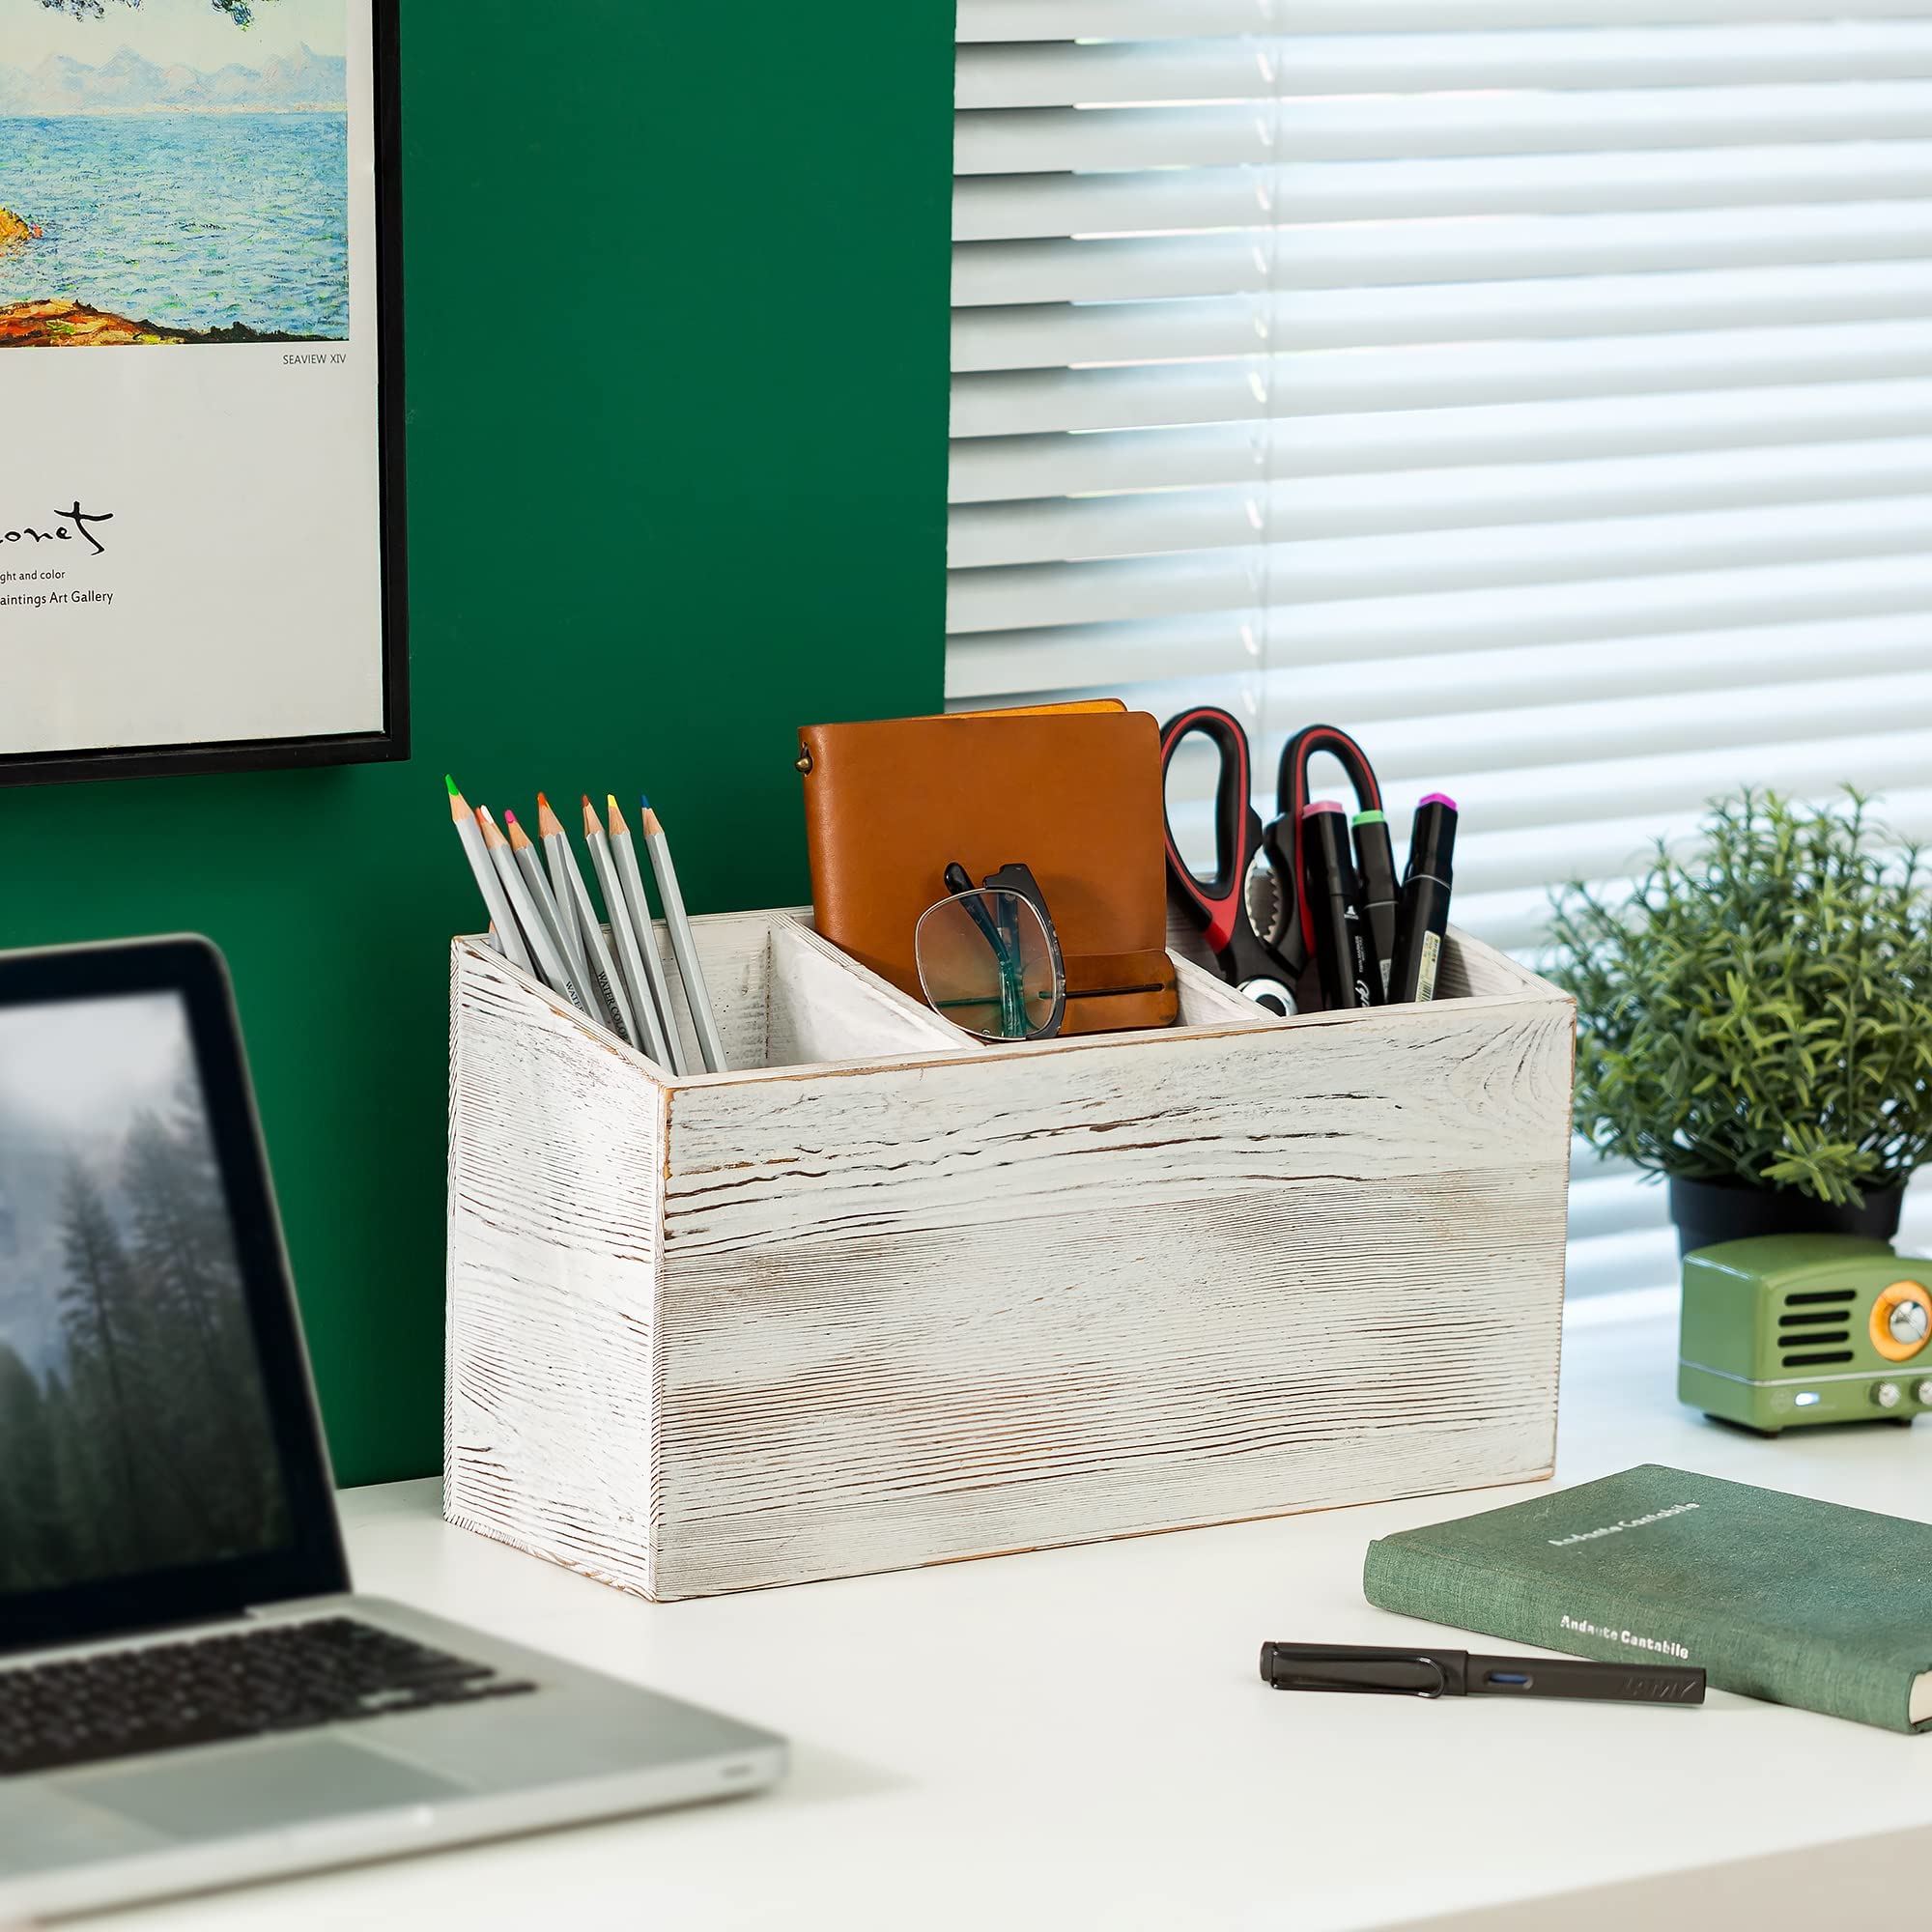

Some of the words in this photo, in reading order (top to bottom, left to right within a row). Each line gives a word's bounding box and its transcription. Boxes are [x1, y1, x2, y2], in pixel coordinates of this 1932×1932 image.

[282, 354, 327, 365] SEAVIEW
[329, 354, 347, 364] XIV
[0, 500, 114, 555] onet
[18, 570, 38, 581] and
[40, 569, 66, 580] color
[0, 594, 46, 608] aintings
[49, 591, 68, 604] Art
[71, 589, 114, 606] Gallery
[598, 971, 615, 1006] WATER
[1620, 1630, 1690, 1661] Cantabile
